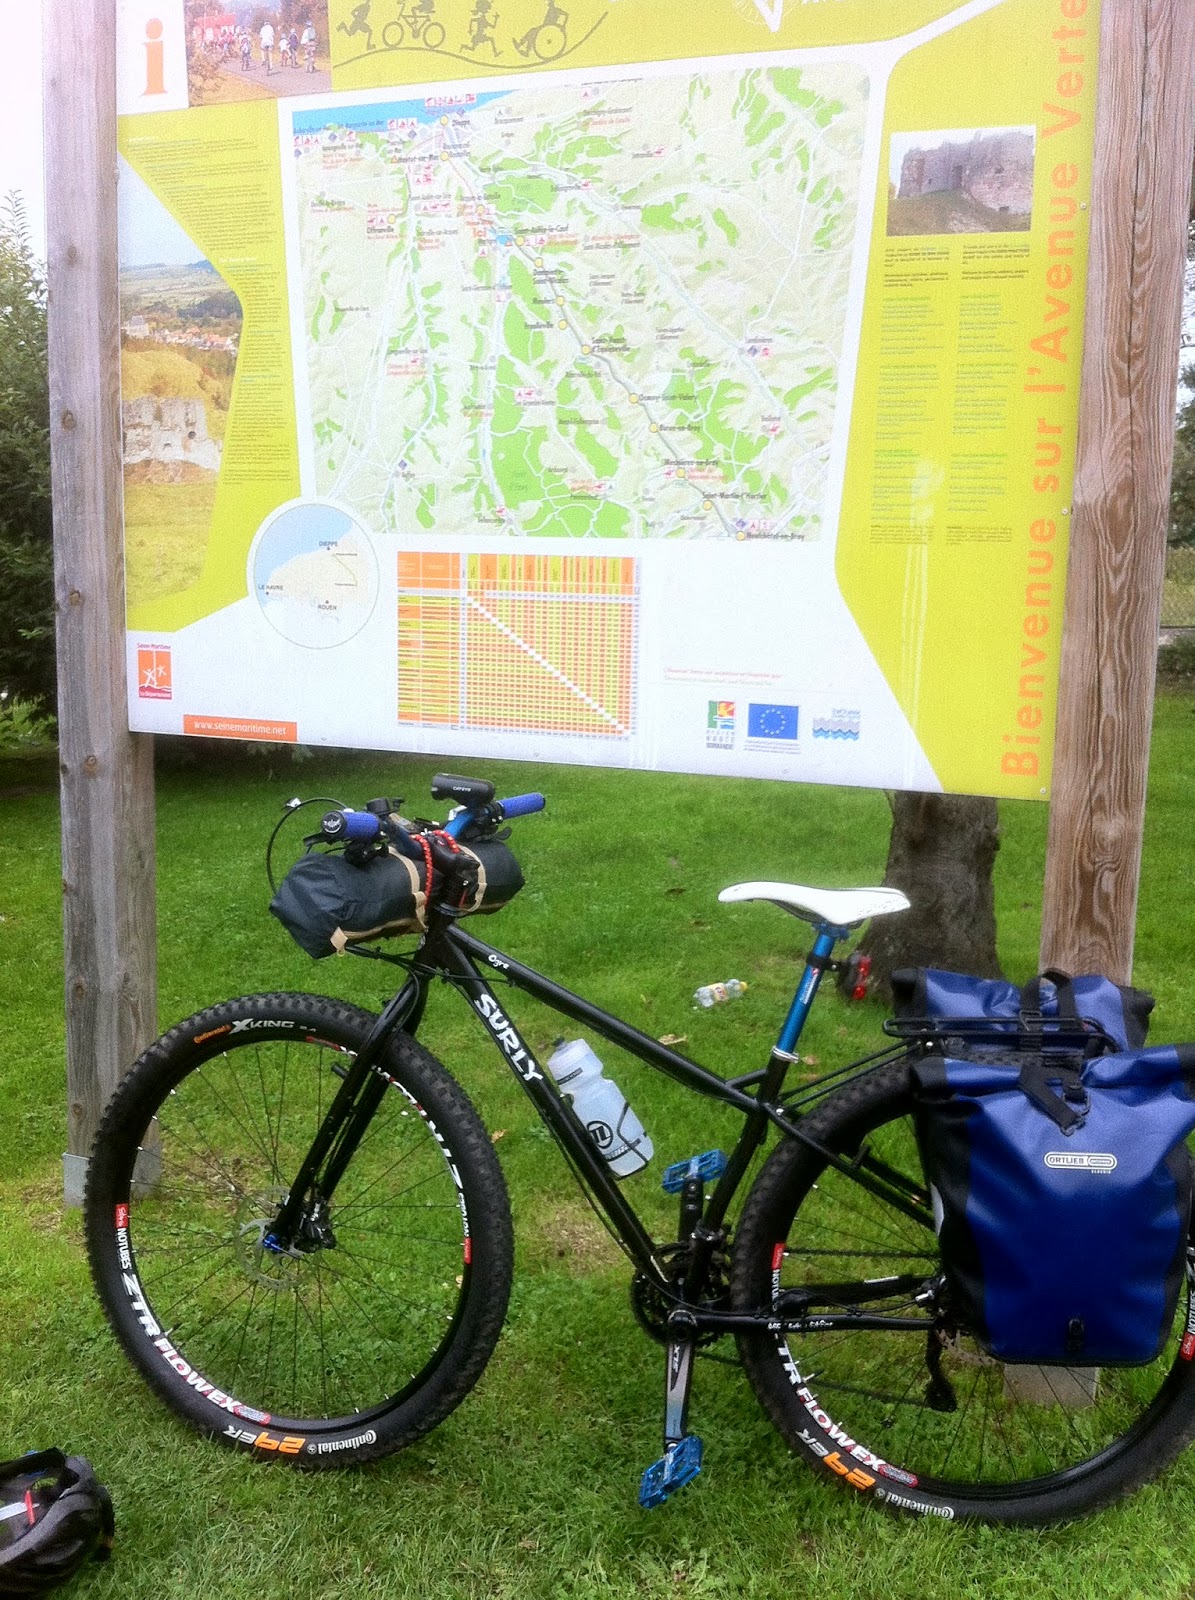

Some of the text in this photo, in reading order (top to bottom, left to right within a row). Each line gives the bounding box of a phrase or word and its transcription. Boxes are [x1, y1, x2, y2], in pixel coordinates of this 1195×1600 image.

[1001, 0, 1088, 777] Bienvenue sur l'Avenue Verte
[193, 720, 286, 735] www.seinemaritime.net
[474, 993, 544, 1081] SURLY
[1048, 1155, 1085, 1165] ORTLIEB
[121, 1272, 162, 1338] ZTR
[318, 1430, 377, 1455] Continental
[885, 1491, 955, 1520] Continental
